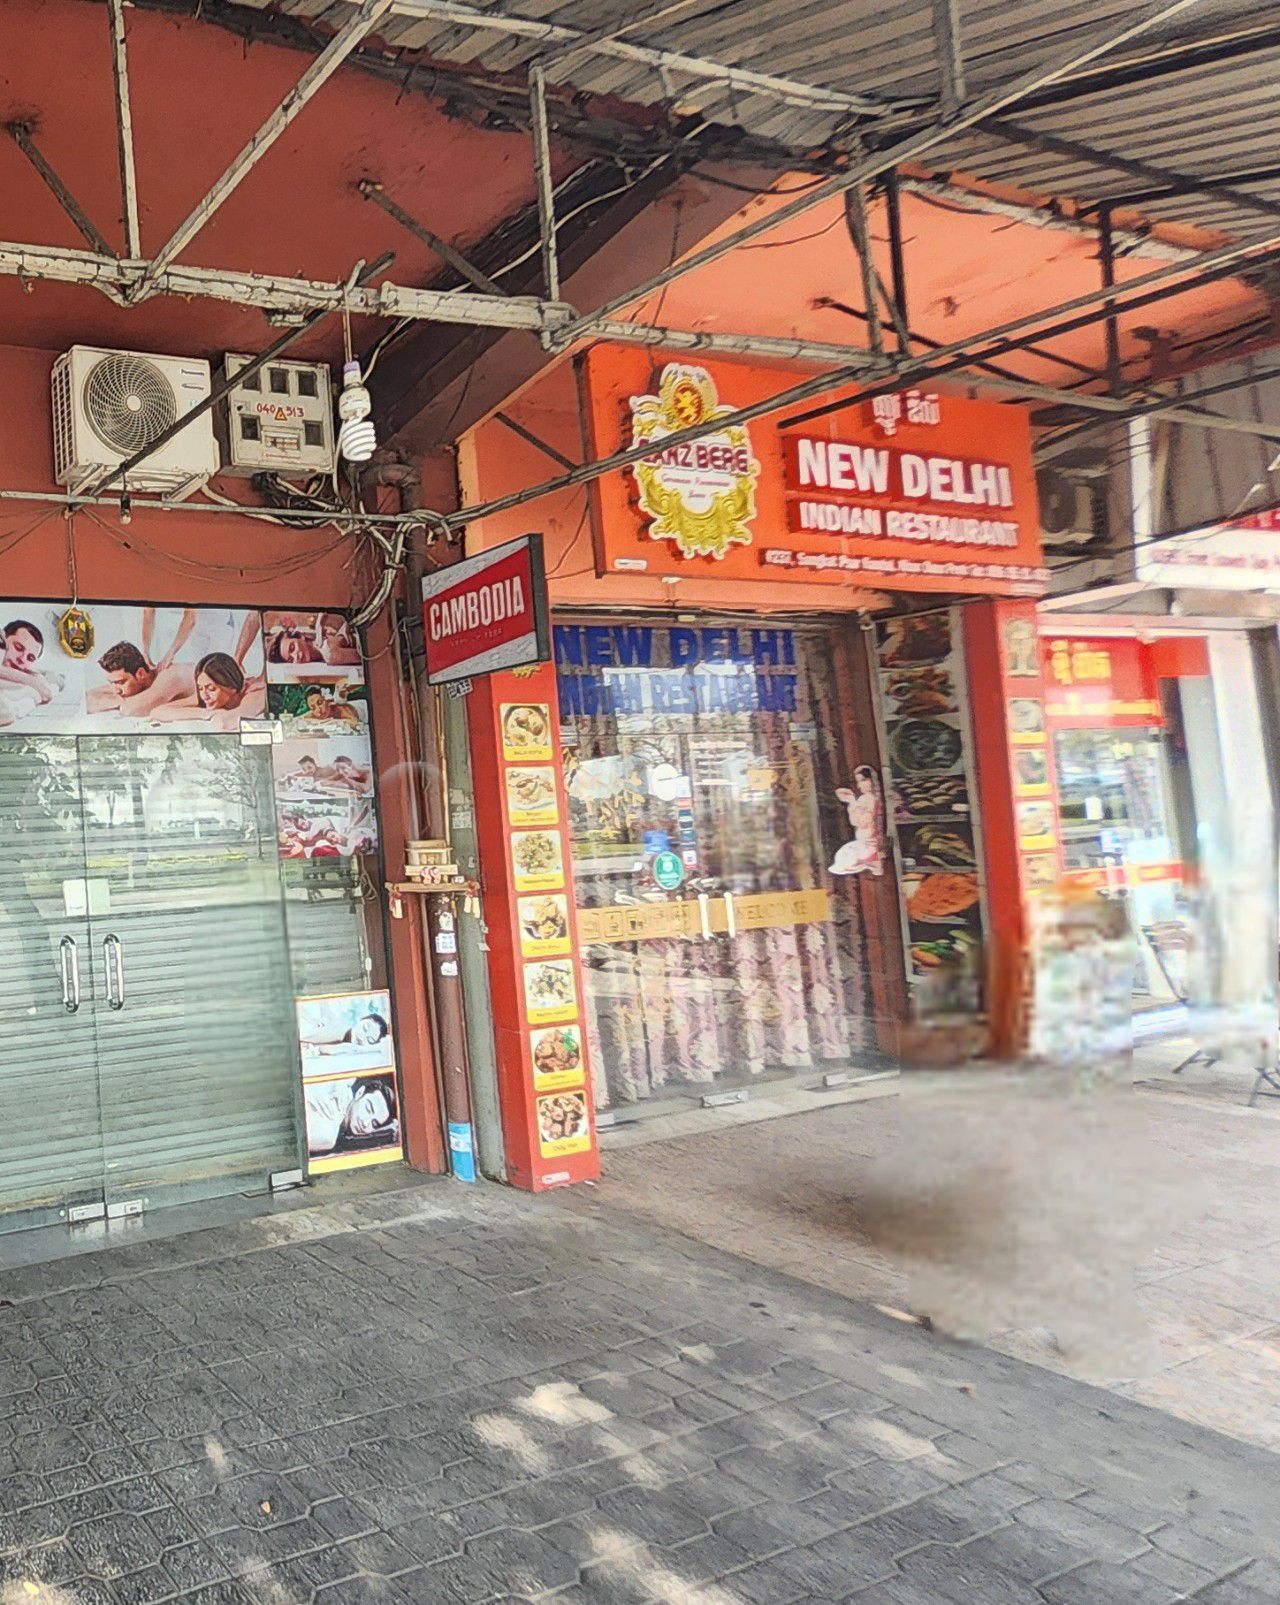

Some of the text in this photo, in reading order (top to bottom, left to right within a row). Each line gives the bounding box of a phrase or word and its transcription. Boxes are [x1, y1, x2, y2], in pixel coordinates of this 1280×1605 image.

[797, 438, 1014, 507] NEW DELHI
[799, 501, 1020, 547] INDIAN RESTAURANT
[429, 574, 525, 642] CAMBODIA
[554, 625, 796, 666] NEW DELHI
